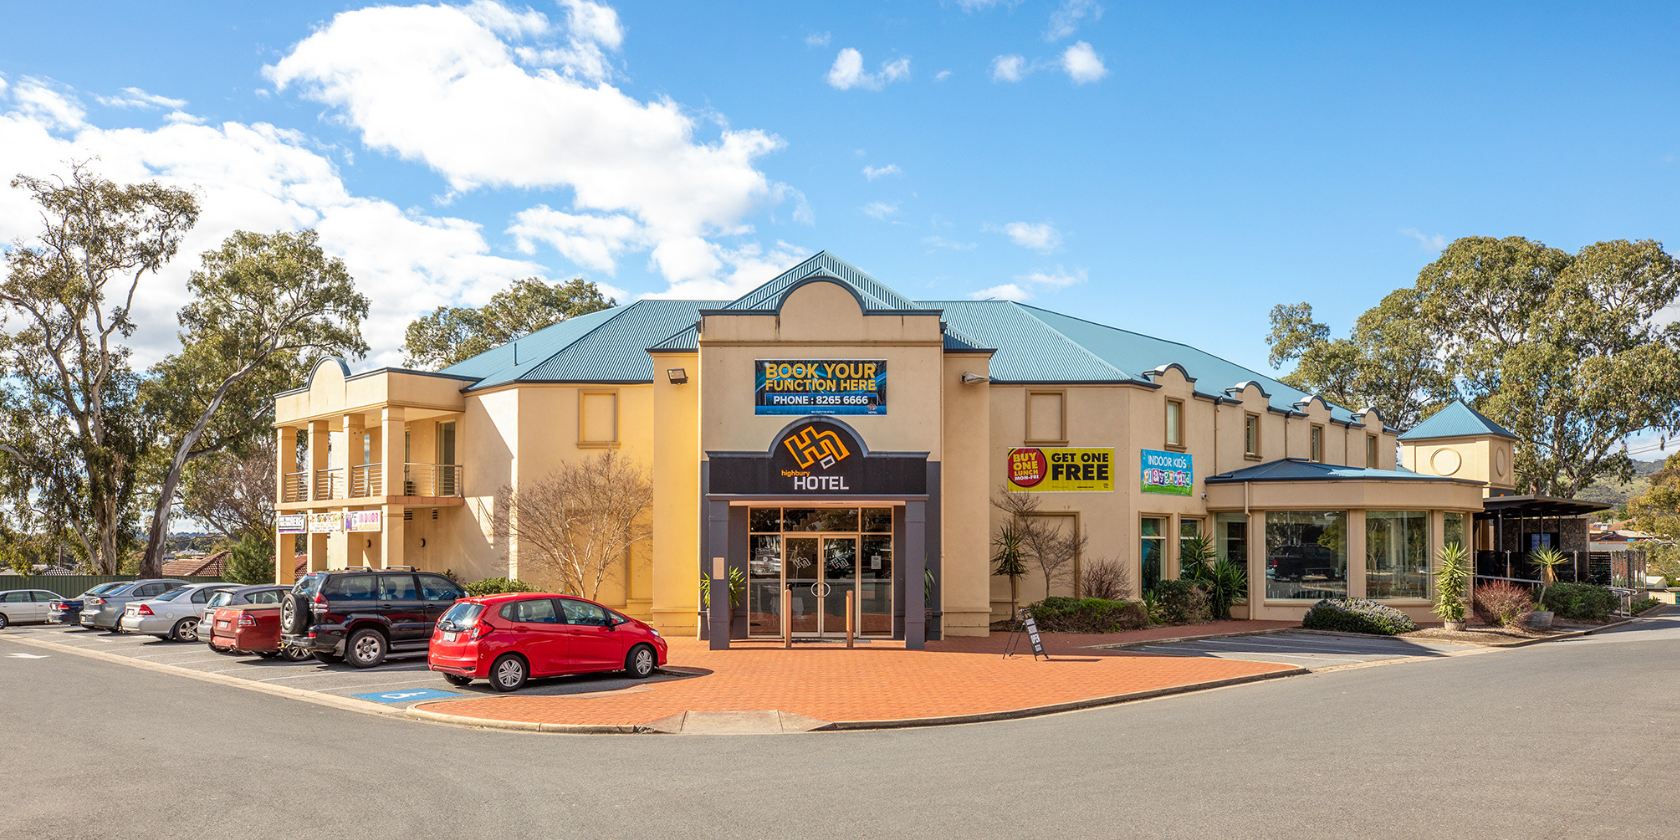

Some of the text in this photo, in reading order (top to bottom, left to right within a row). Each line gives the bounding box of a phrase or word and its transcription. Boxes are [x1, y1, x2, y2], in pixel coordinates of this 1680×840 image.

[765, 363, 876, 379] BOOK YOUR
[765, 379, 876, 391] FUNCTION HERE
[773, 396, 809, 405] PHONE
[816, 396, 841, 405] 8265
[843, 396, 869, 405] 6666
[1012, 452, 1037, 463] BUY
[1051, 453, 1109, 463] GET ONE
[1147, 455, 1172, 467] INDOOR
[1013, 461, 1038, 471] ONE
[781, 470, 811, 478] highbury
[1014, 469, 1039, 477] LUNCH
[1051, 464, 1109, 481] FREE
[794, 476, 850, 490] HOTEL
